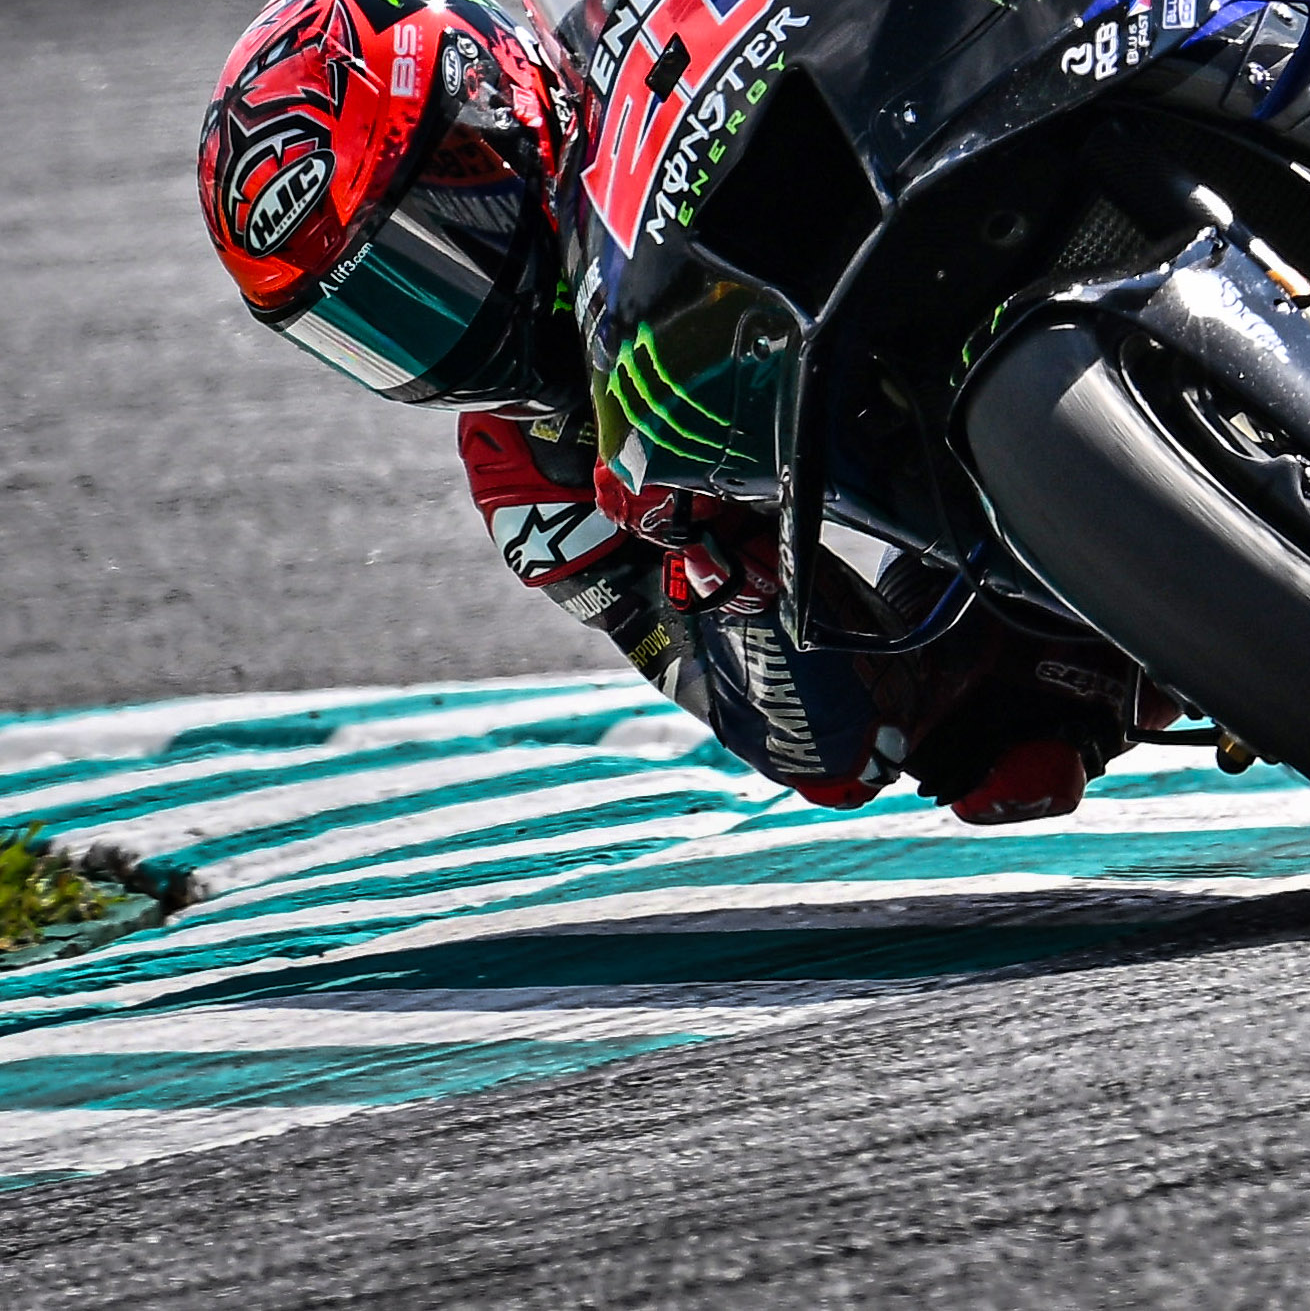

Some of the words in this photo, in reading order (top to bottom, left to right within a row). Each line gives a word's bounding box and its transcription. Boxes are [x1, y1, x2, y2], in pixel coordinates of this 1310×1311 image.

[391, 24, 416, 97] BS
[1095, 21, 1118, 80] RCB
[677, 49, 786, 228] ENERGY
[252, 158, 320, 249] HJC
[727, 626, 826, 774] YAMAHA
